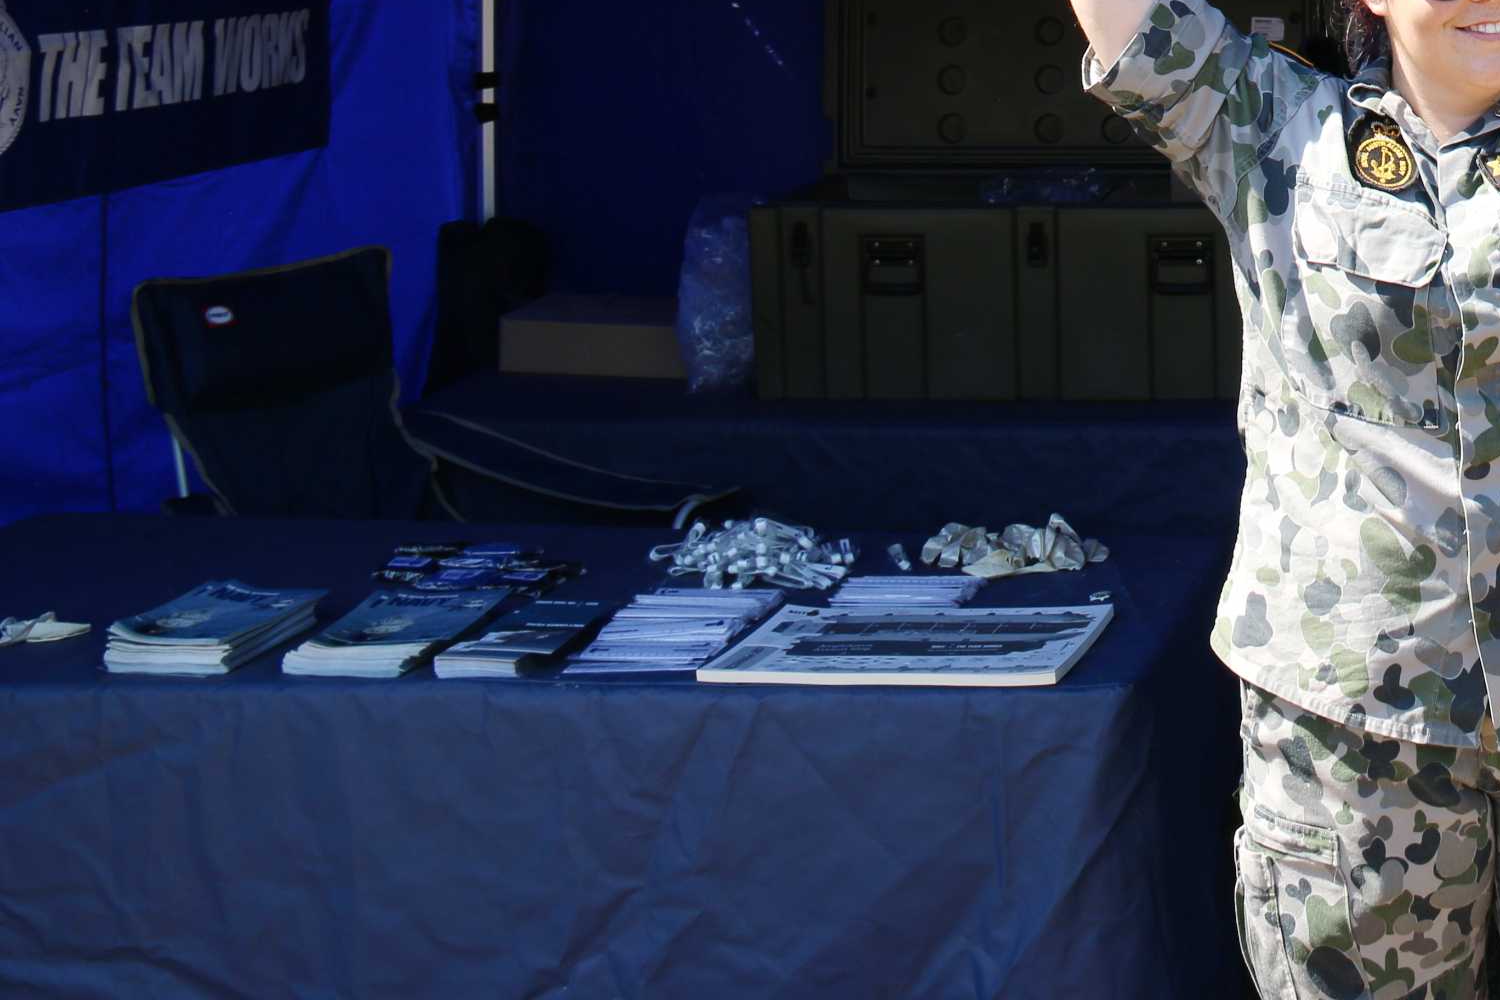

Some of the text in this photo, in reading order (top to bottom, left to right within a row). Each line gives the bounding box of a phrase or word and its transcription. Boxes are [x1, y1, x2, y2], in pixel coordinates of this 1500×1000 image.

[37, 8, 310, 122] THE TEAM WORKS
